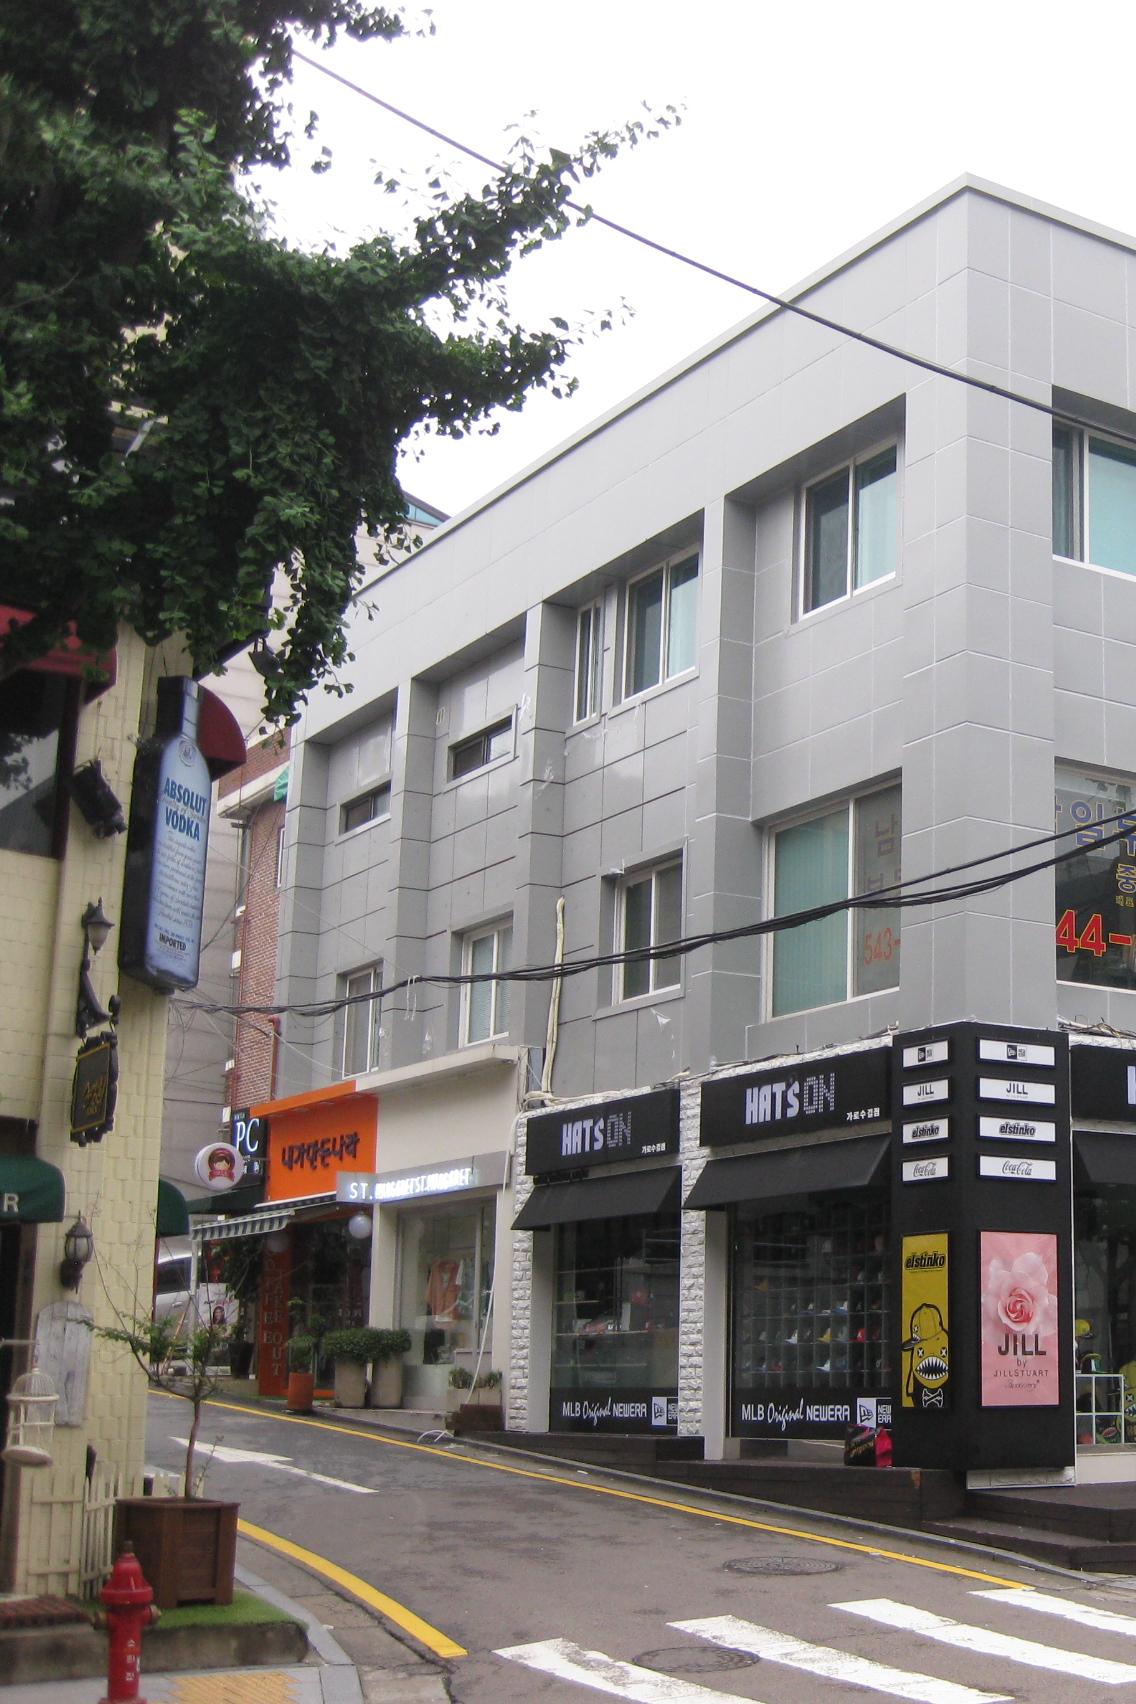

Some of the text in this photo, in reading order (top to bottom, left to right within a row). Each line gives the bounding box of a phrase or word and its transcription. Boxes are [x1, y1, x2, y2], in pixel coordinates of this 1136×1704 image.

[164, 777, 206, 816] ABSOLUT
[165, 806, 200, 841] VODKA
[159, 932, 187, 951] IMPORTED
[803, 1072, 836, 1115] ON
[917, 1084, 935, 1097] JILL
[1006, 1082, 1029, 1096] JILL
[846, 1107, 881, 1122] 가로수길점
[235, 1117, 261, 1152] PC
[606, 1112, 633, 1148] ON
[641, 1142, 667, 1154] 가로수길점
[349, 1182, 373, 1200] ST.
[3, 1192, 20, 1212] R
[905, 1251, 945, 1270] elstinko
[263, 1250, 277, 1344] OFFEE
[998, 1333, 1046, 1356] JILL
[1016, 1358, 1027, 1368] by
[562, 1401, 581, 1417] MLB
[582, 1396, 612, 1427] Original
[741, 1403, 765, 1421] MLB
[767, 1398, 804, 1432] Original
[877, 1404, 892, 1414] NEW
[877, 1414, 892, 1424] ERA
